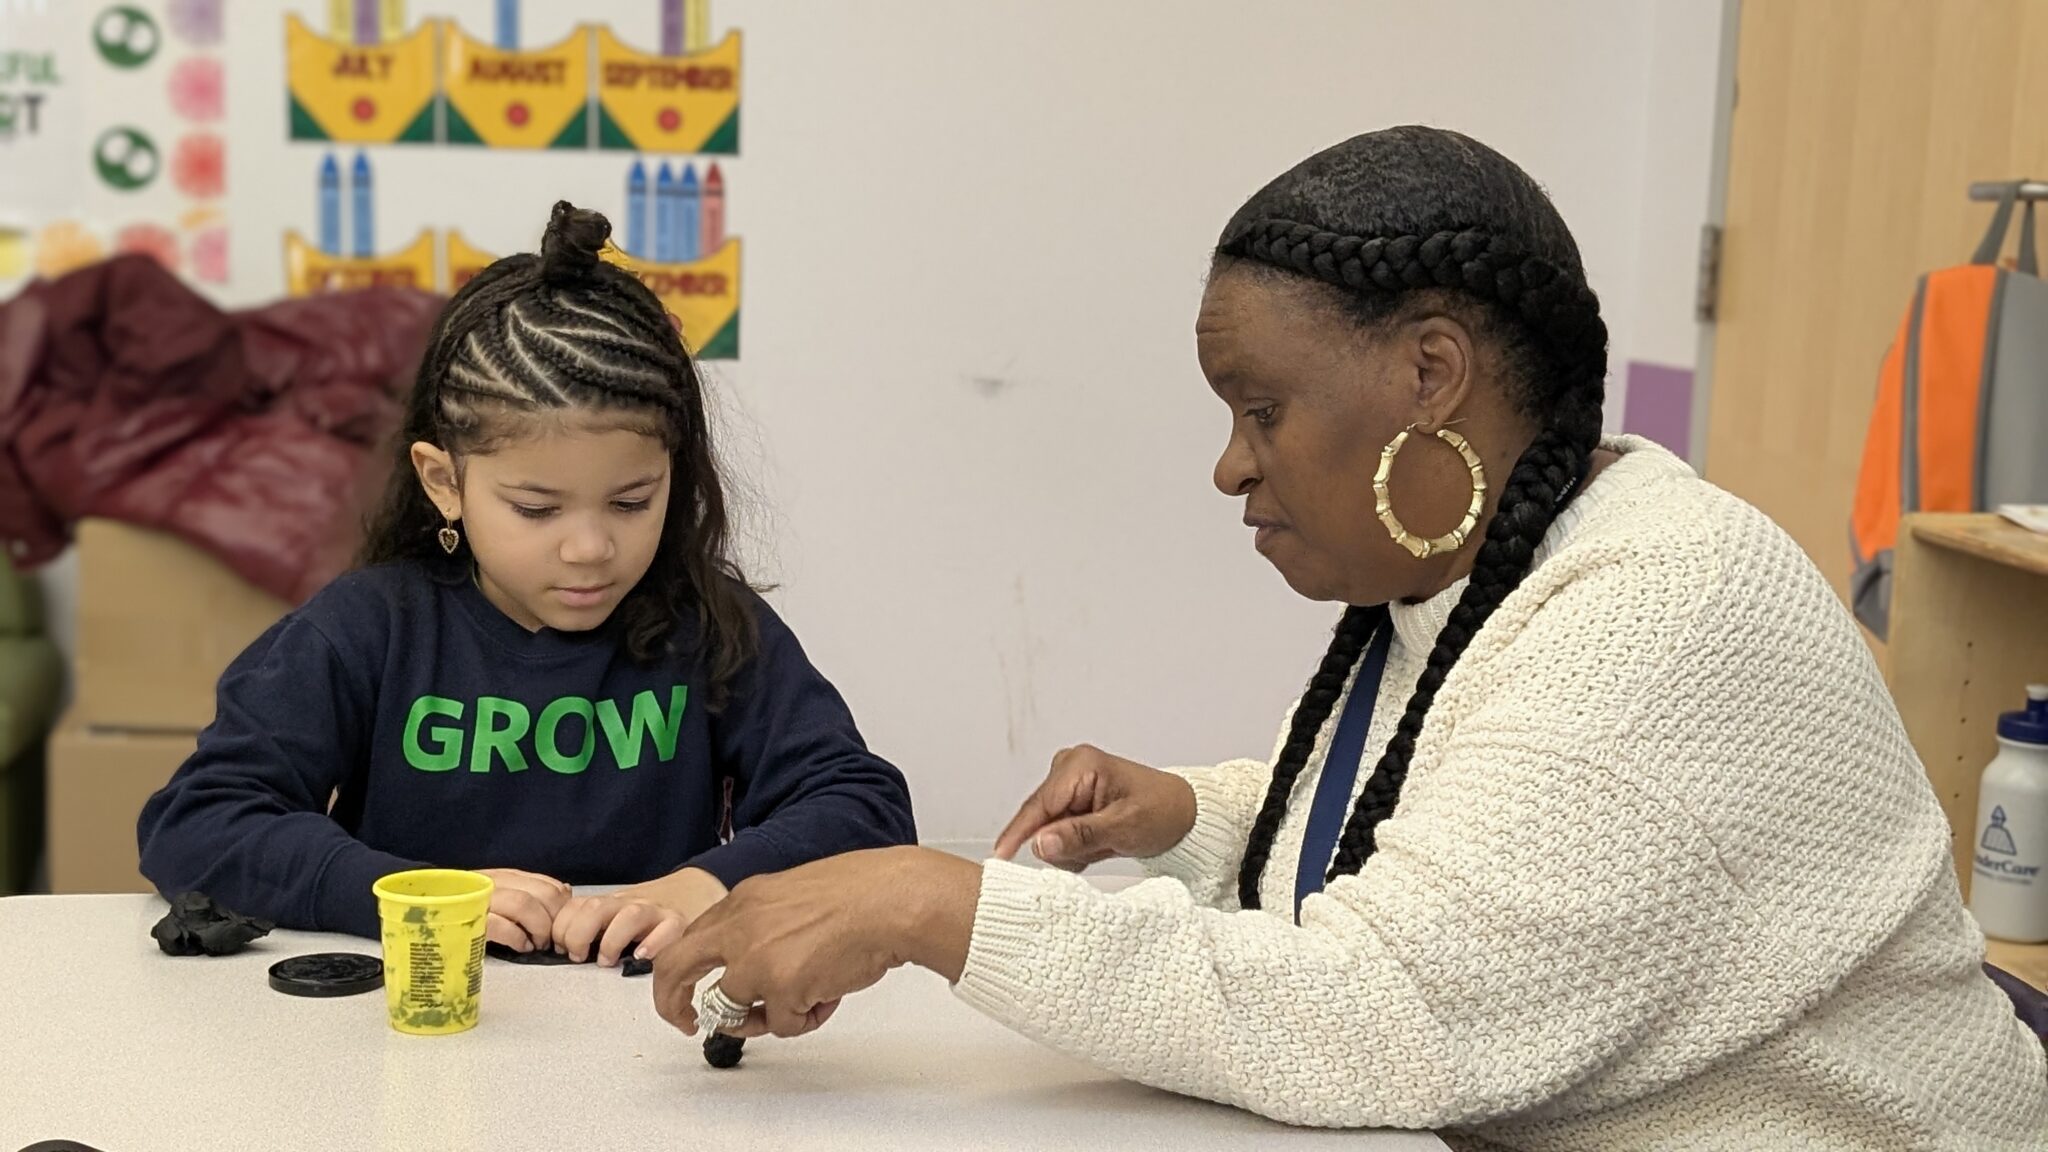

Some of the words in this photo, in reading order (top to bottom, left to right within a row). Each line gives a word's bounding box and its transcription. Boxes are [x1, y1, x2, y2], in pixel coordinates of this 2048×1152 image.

[331, 52, 394, 81] JULY
[467, 56, 568, 86] AUGUST
[603, 61, 735, 90] SEPTEMBER
[639, 270, 728, 297] CEMBER
[402, 685, 688, 774] GROW
[1974, 854, 2042, 877] nderCare
